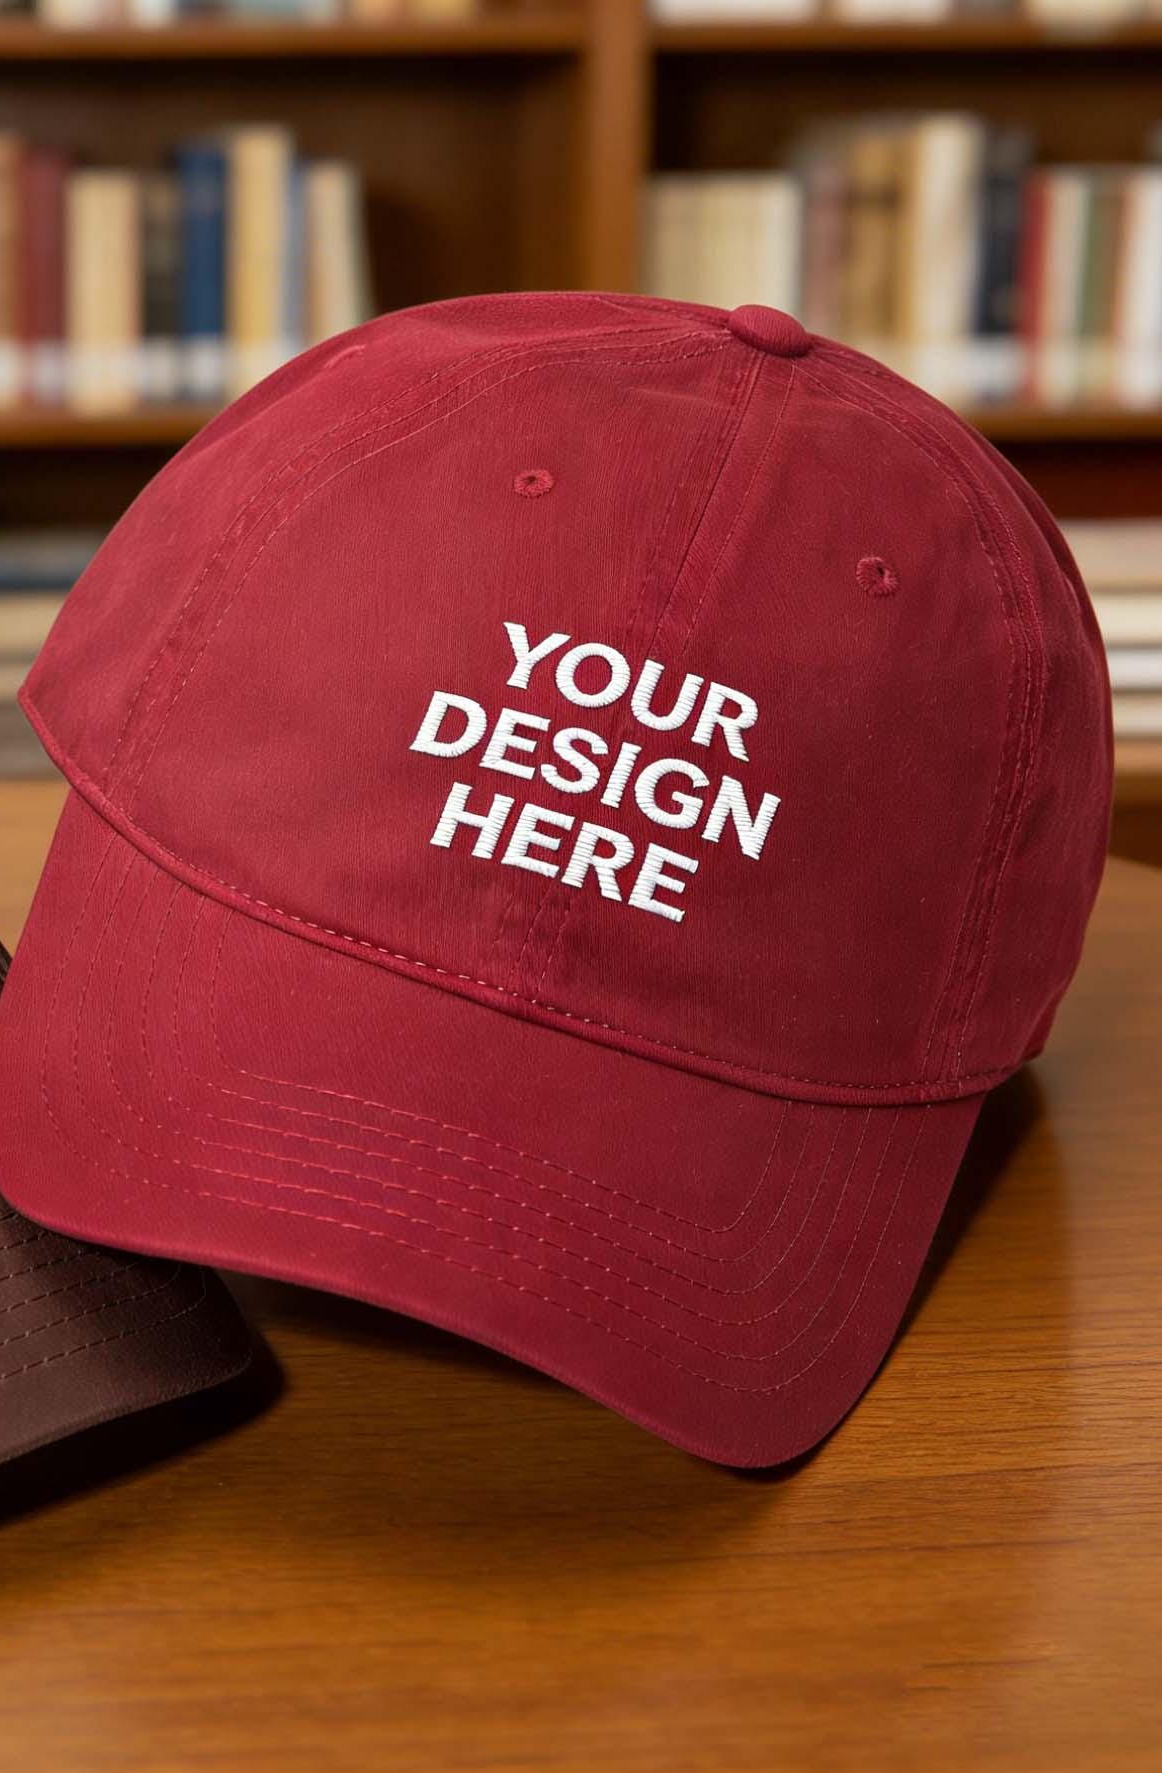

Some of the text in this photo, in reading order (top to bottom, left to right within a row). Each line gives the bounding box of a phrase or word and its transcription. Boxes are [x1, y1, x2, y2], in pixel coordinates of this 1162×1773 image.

[502, 621, 759, 762] YOUR
[409, 690, 782, 861] DESIGN
[430, 781, 700, 923] HERE
